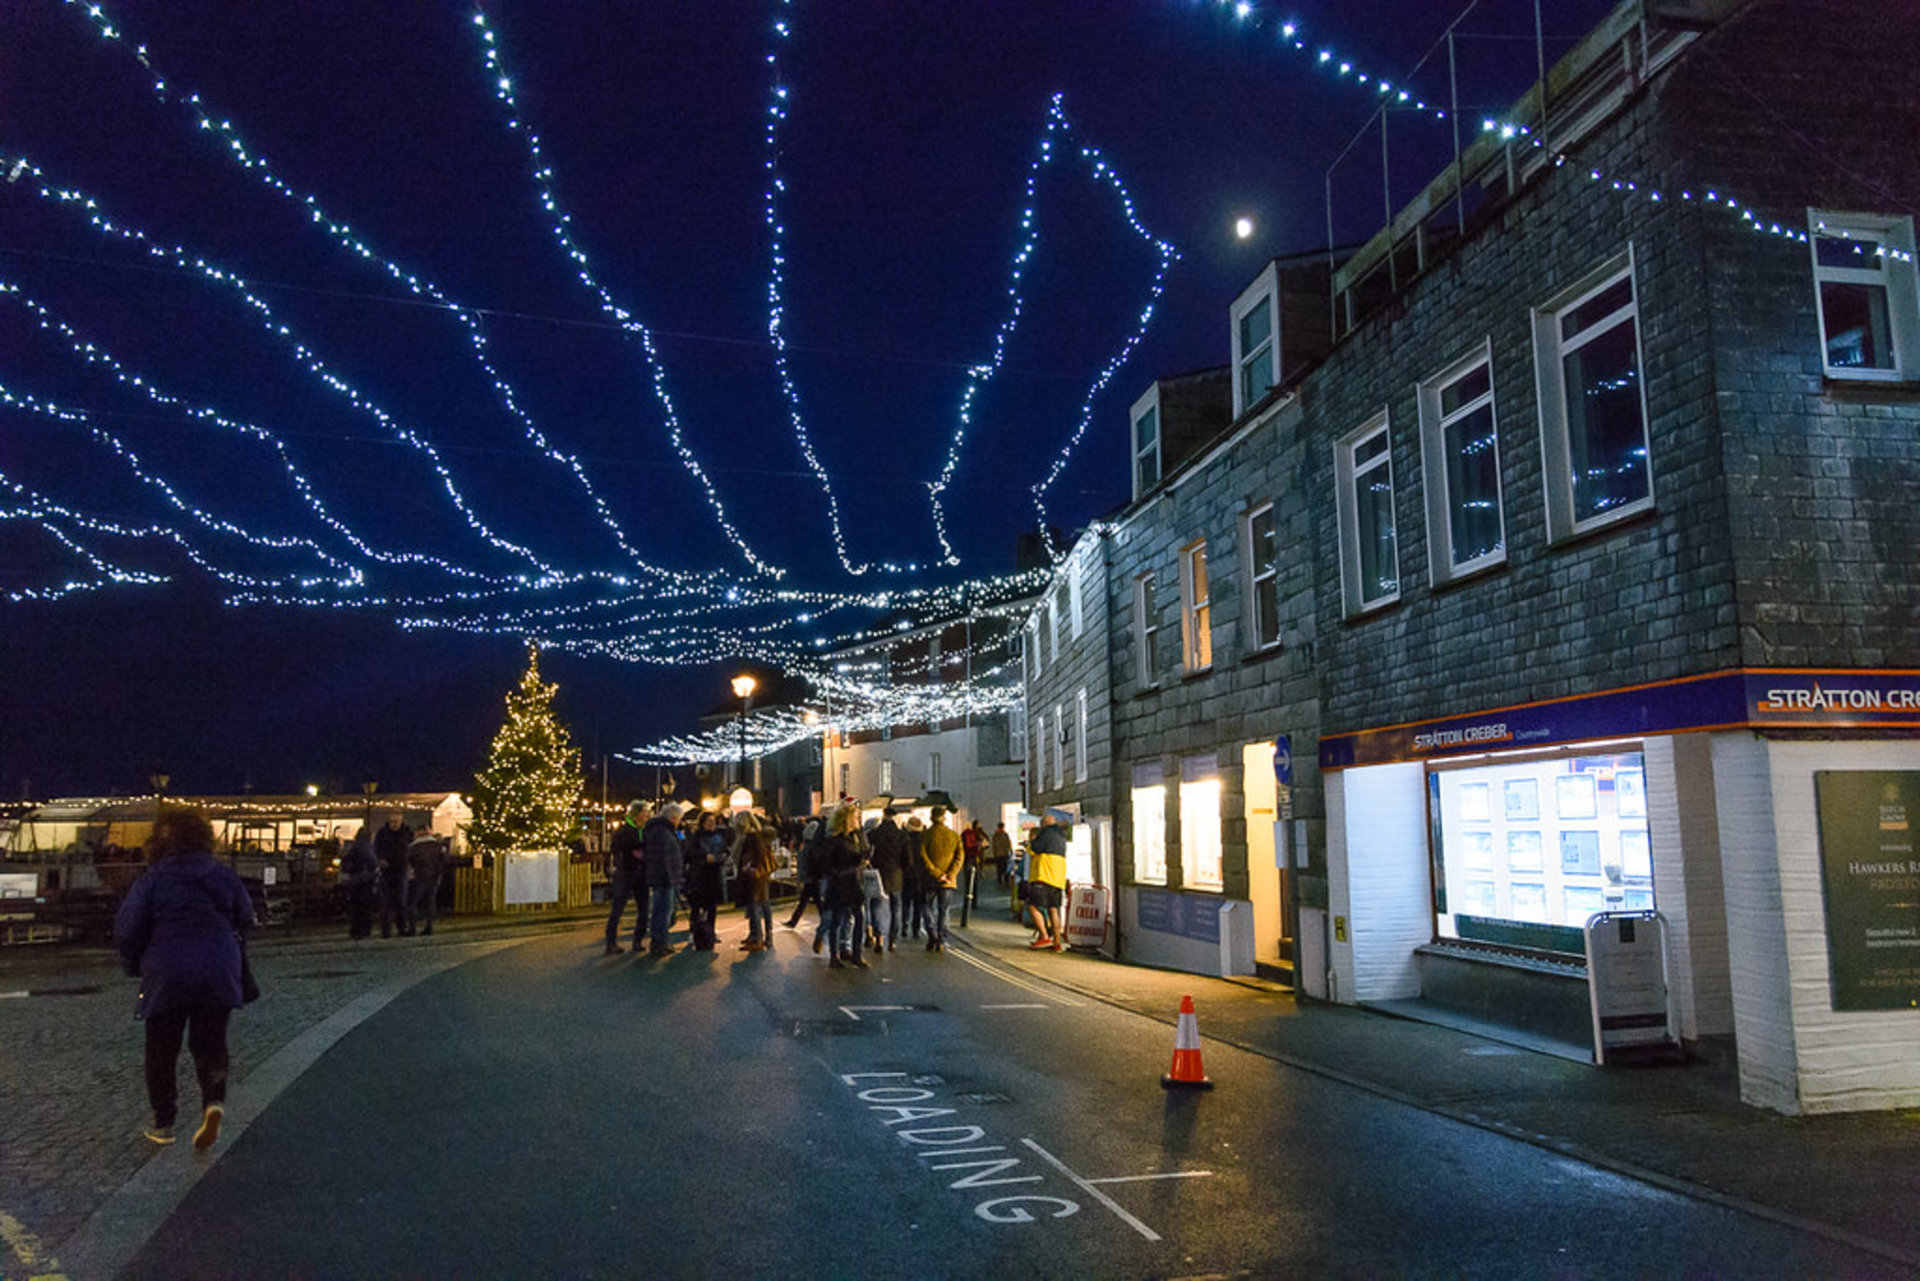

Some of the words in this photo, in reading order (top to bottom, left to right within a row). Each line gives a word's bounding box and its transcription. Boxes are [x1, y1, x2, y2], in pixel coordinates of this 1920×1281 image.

[1768, 684, 1880, 709] STRATTON
[1414, 729, 1463, 748] STRATTON
[1464, 723, 1508, 741] CREBER
[1083, 892, 1095, 904] ICE
[1076, 906, 1100, 919] CREAM
[841, 1072, 1080, 1223] LOADING
